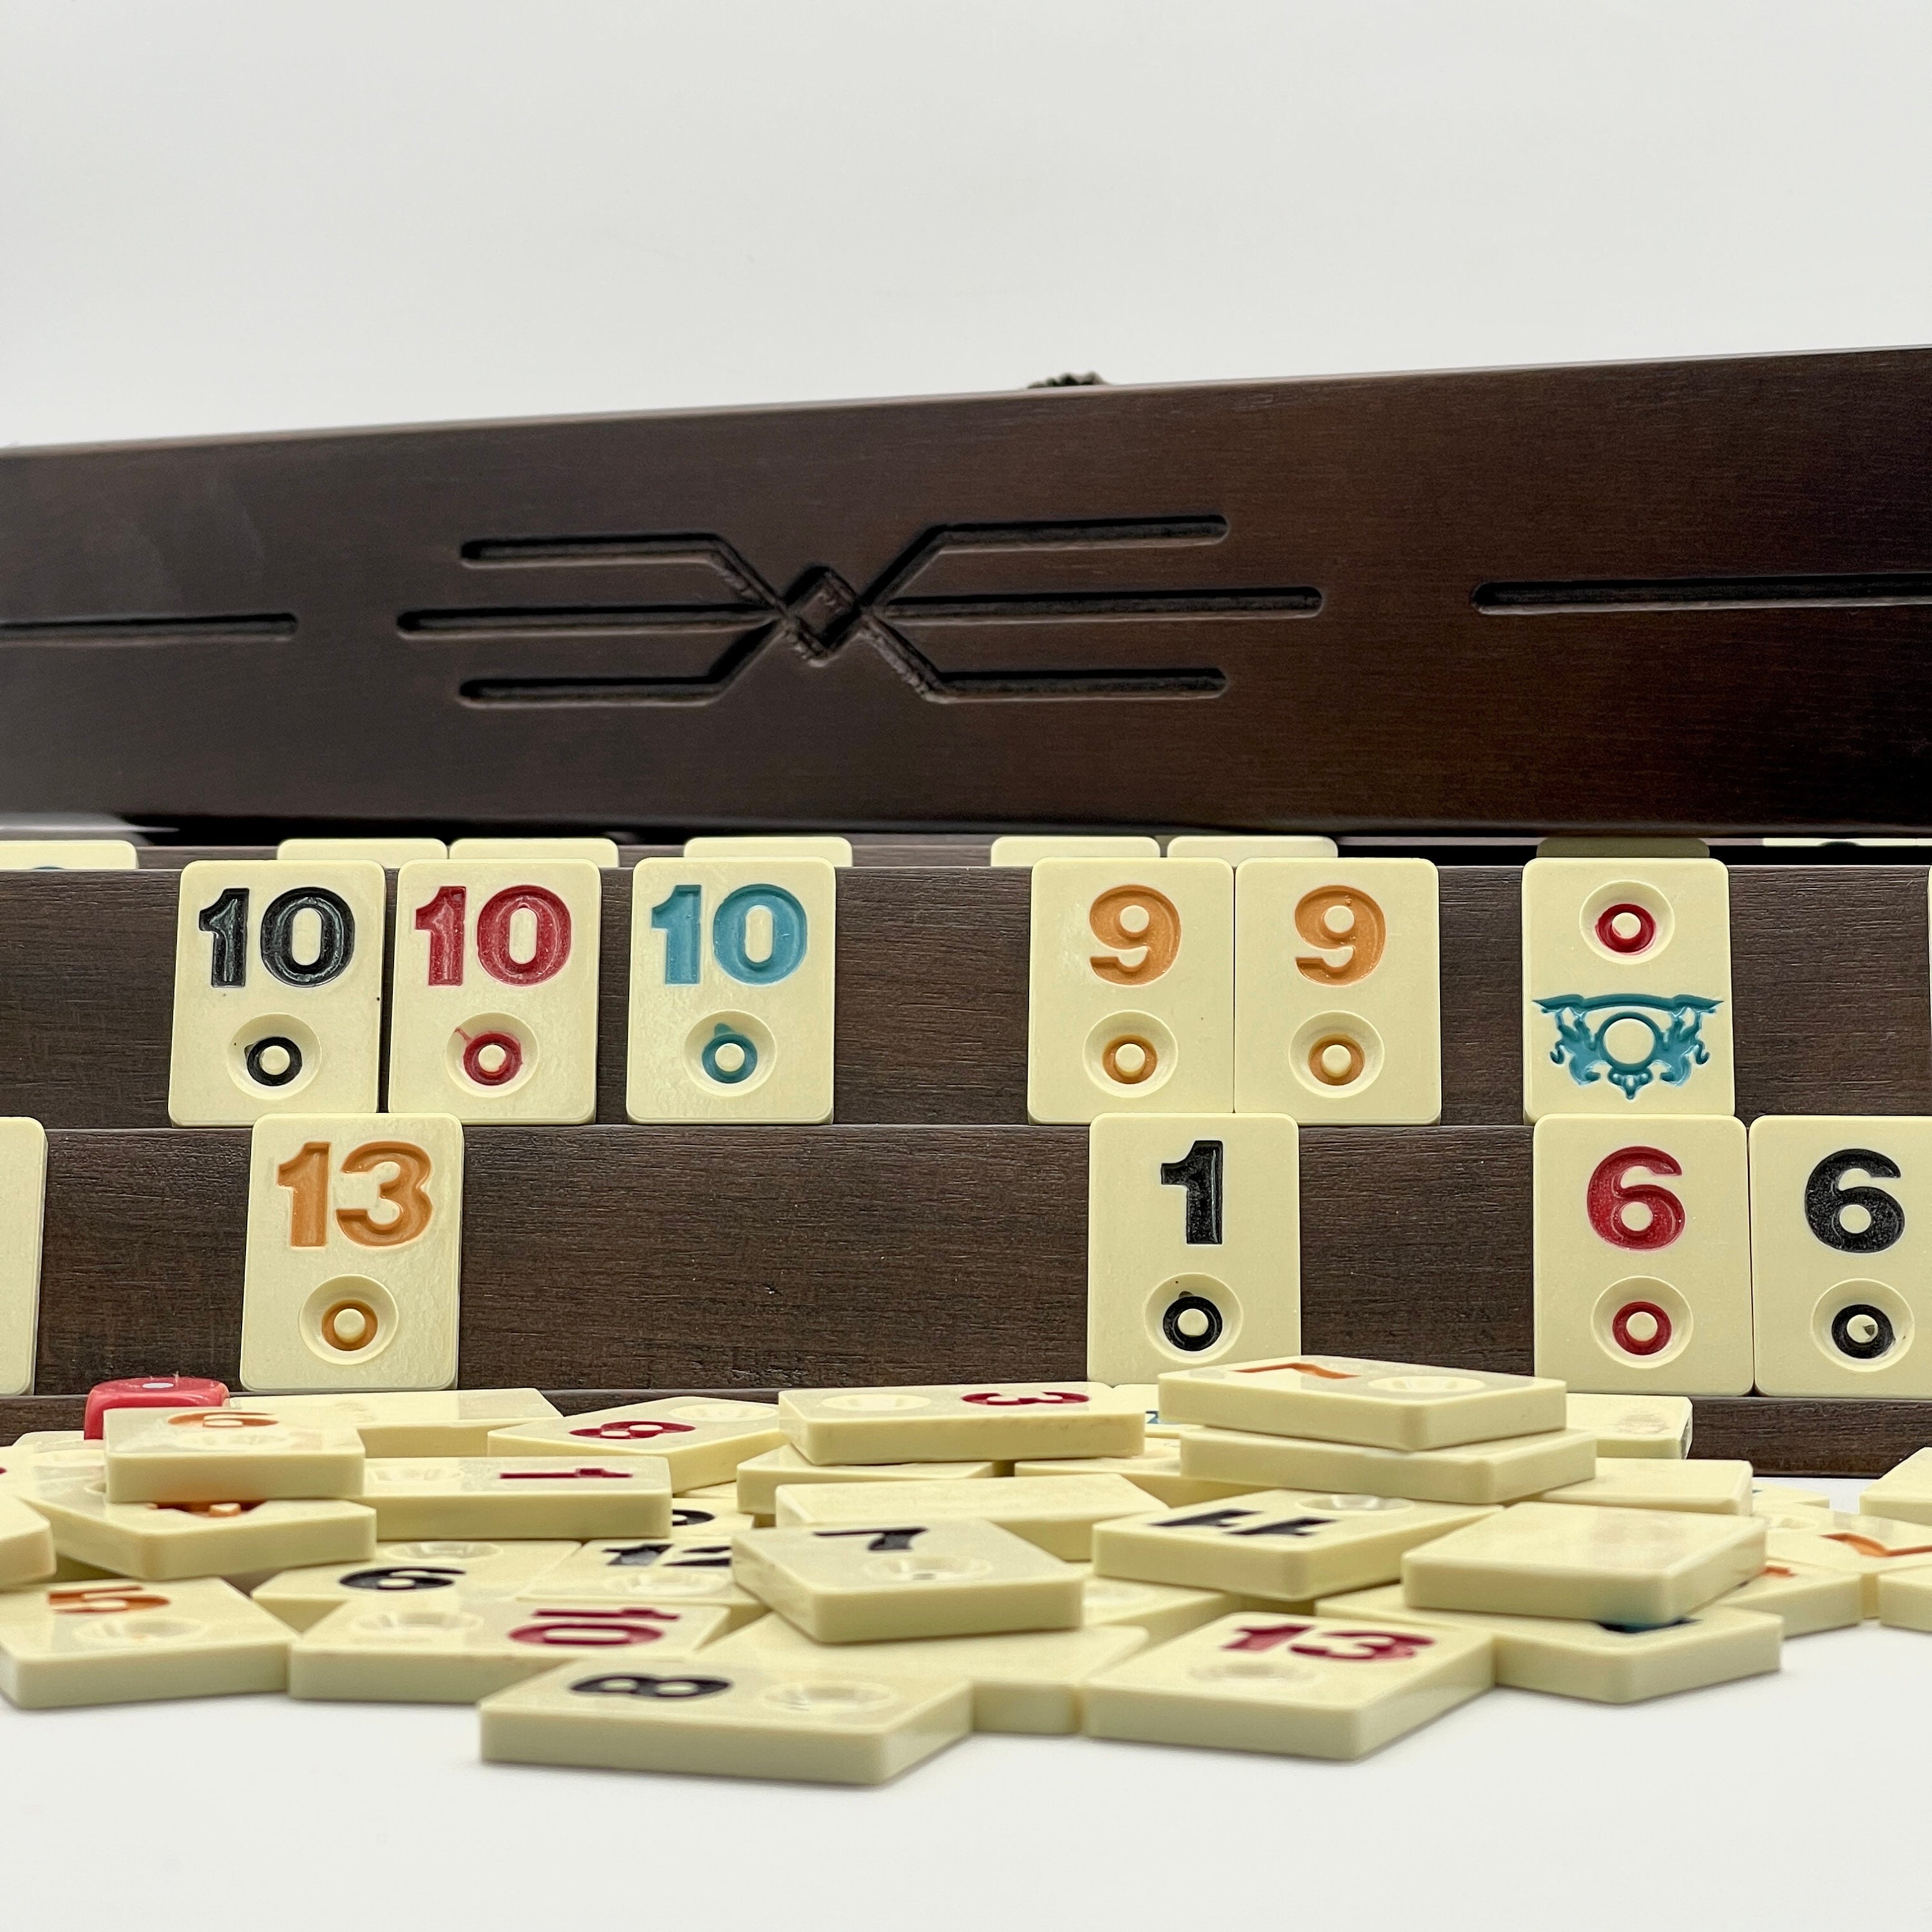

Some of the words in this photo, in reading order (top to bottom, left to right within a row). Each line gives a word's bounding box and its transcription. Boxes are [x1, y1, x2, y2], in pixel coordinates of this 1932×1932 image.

[198, 887, 355, 989] 10
[414, 885, 572, 987] 10
[650, 884, 808, 985] 10
[1089, 884, 1182, 986] 9
[1294, 885, 1387, 986] 9
[276, 1141, 433, 1247] 13
[1160, 1139, 1224, 1246] 1
[1586, 1146, 1686, 1252] 6
[1804, 1148, 1906, 1254] 6
[1218, 1622, 1437, 1662] 13
